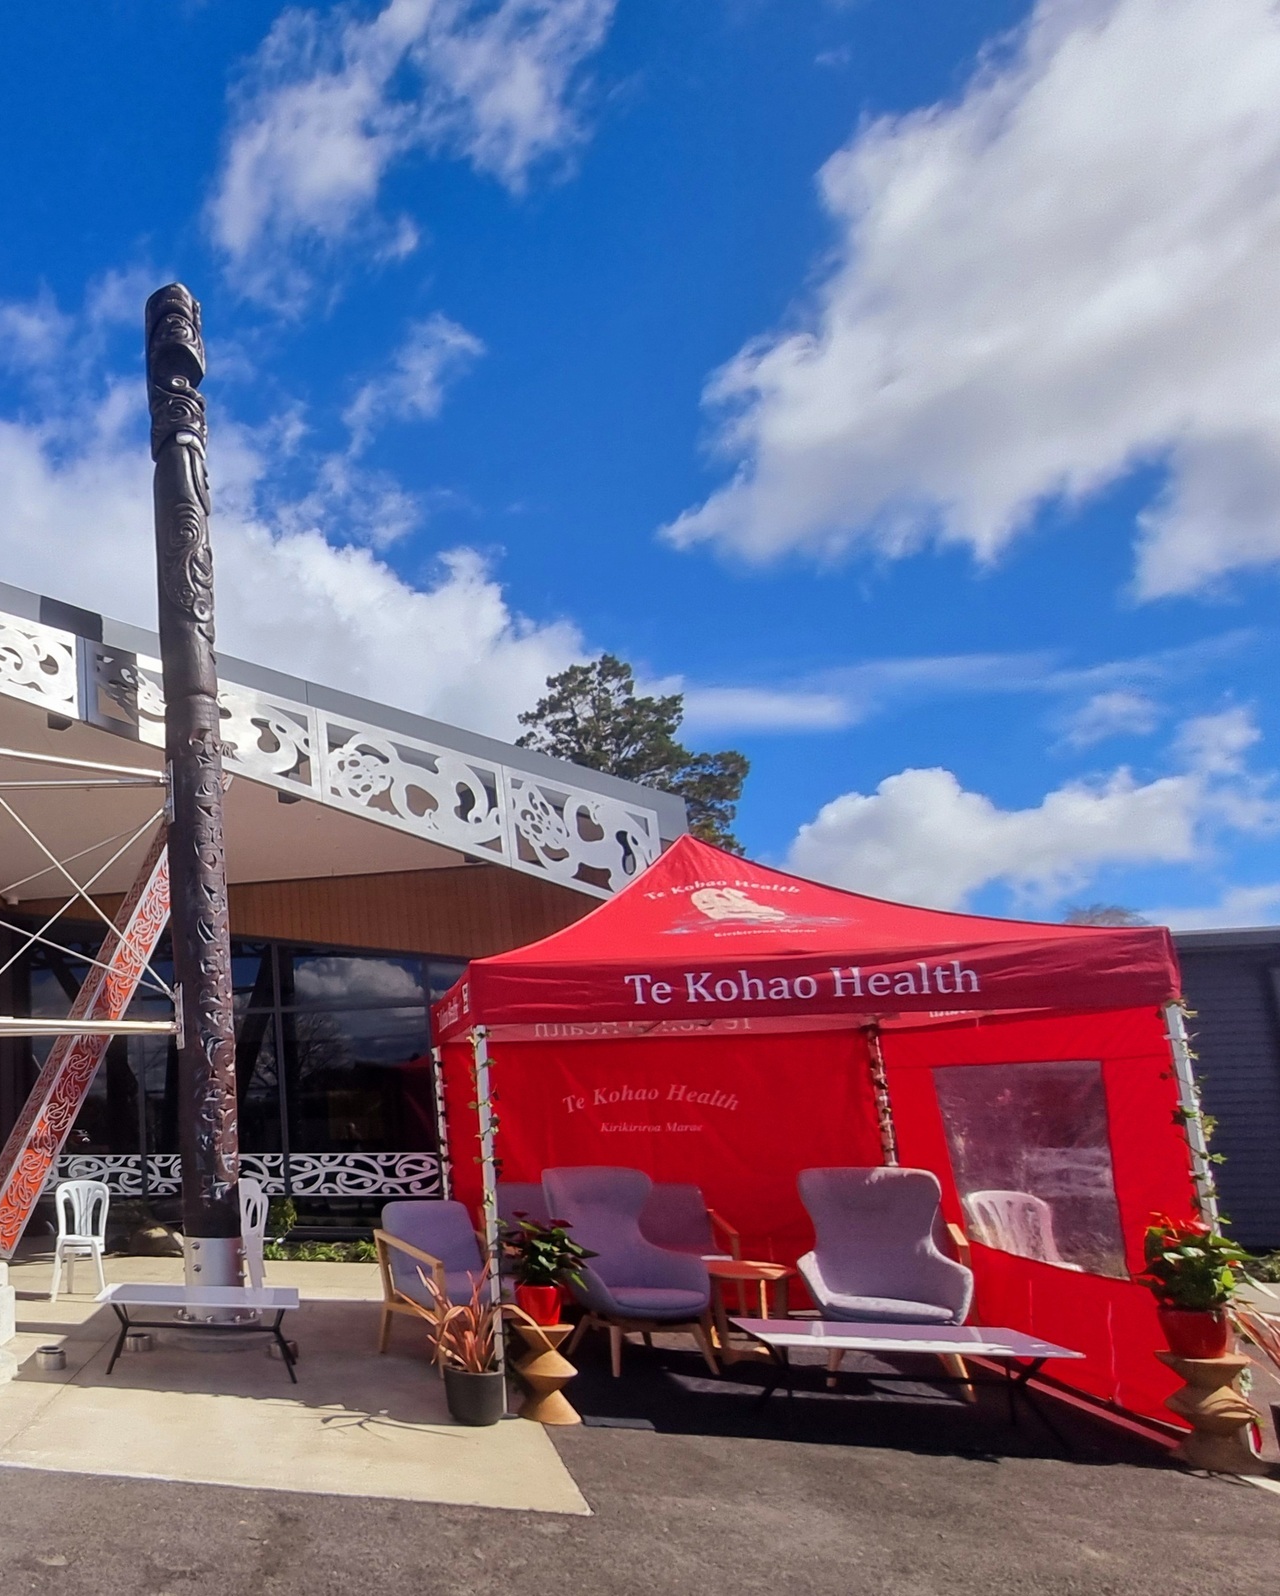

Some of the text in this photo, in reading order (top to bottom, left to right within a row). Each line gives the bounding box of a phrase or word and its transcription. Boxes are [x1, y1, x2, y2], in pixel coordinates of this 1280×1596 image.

[643, 890, 665, 901] Te
[734, 879, 801, 894] Health
[624, 960, 981, 1005] Te Kohao Health
[562, 1083, 739, 1114] Te Kohao Health
[600, 1122, 703, 1132] Kirikiriroa Marae
